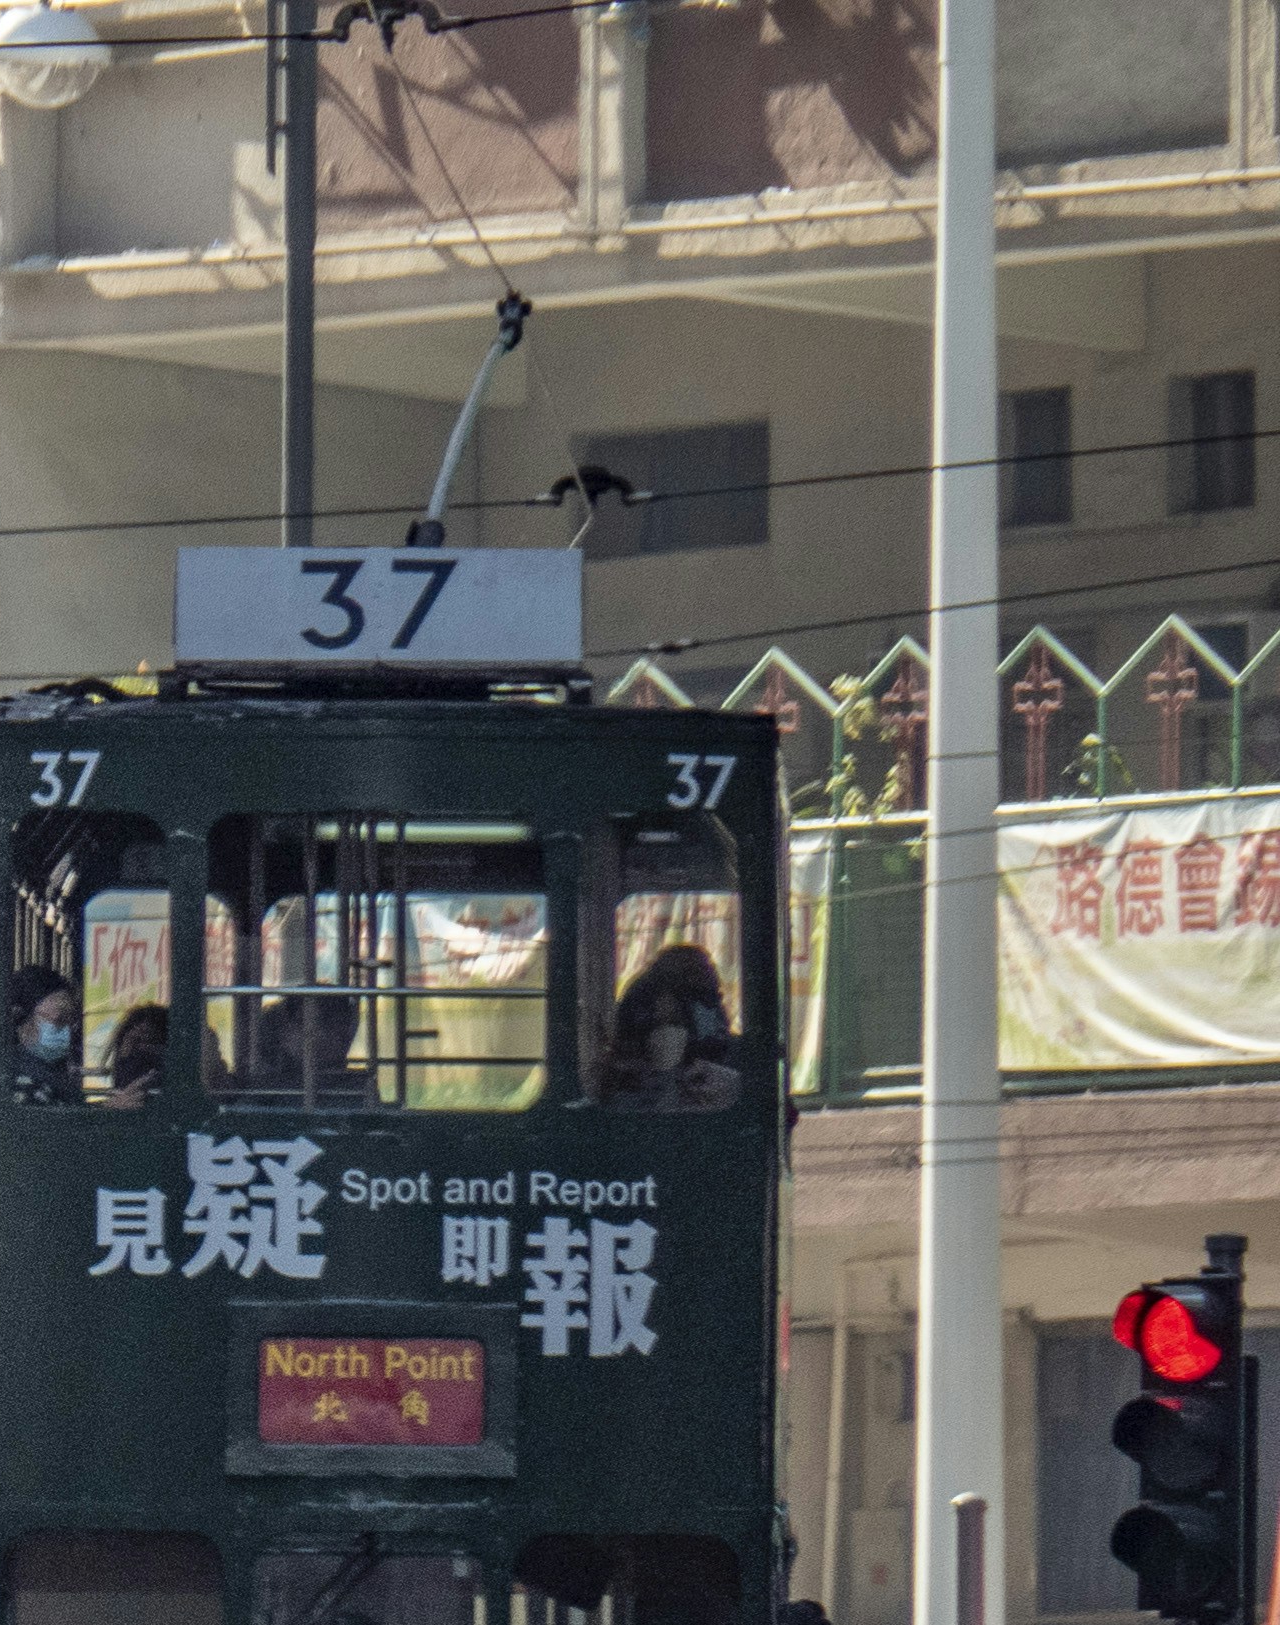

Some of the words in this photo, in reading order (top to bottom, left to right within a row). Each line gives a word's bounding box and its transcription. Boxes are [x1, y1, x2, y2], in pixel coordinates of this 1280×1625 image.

[299, 558, 460, 651] 37
[29, 749, 102, 809] 37
[666, 753, 738, 810] 37
[341, 1169, 432, 1211] Spot
[443, 1171, 516, 1205] and
[529, 1171, 658, 1214] Report
[88, 1133, 329, 1281] 見疑
[441, 1215, 659, 1358] 即報
[263, 1343, 371, 1379] North
[384, 1345, 478, 1382] Point
